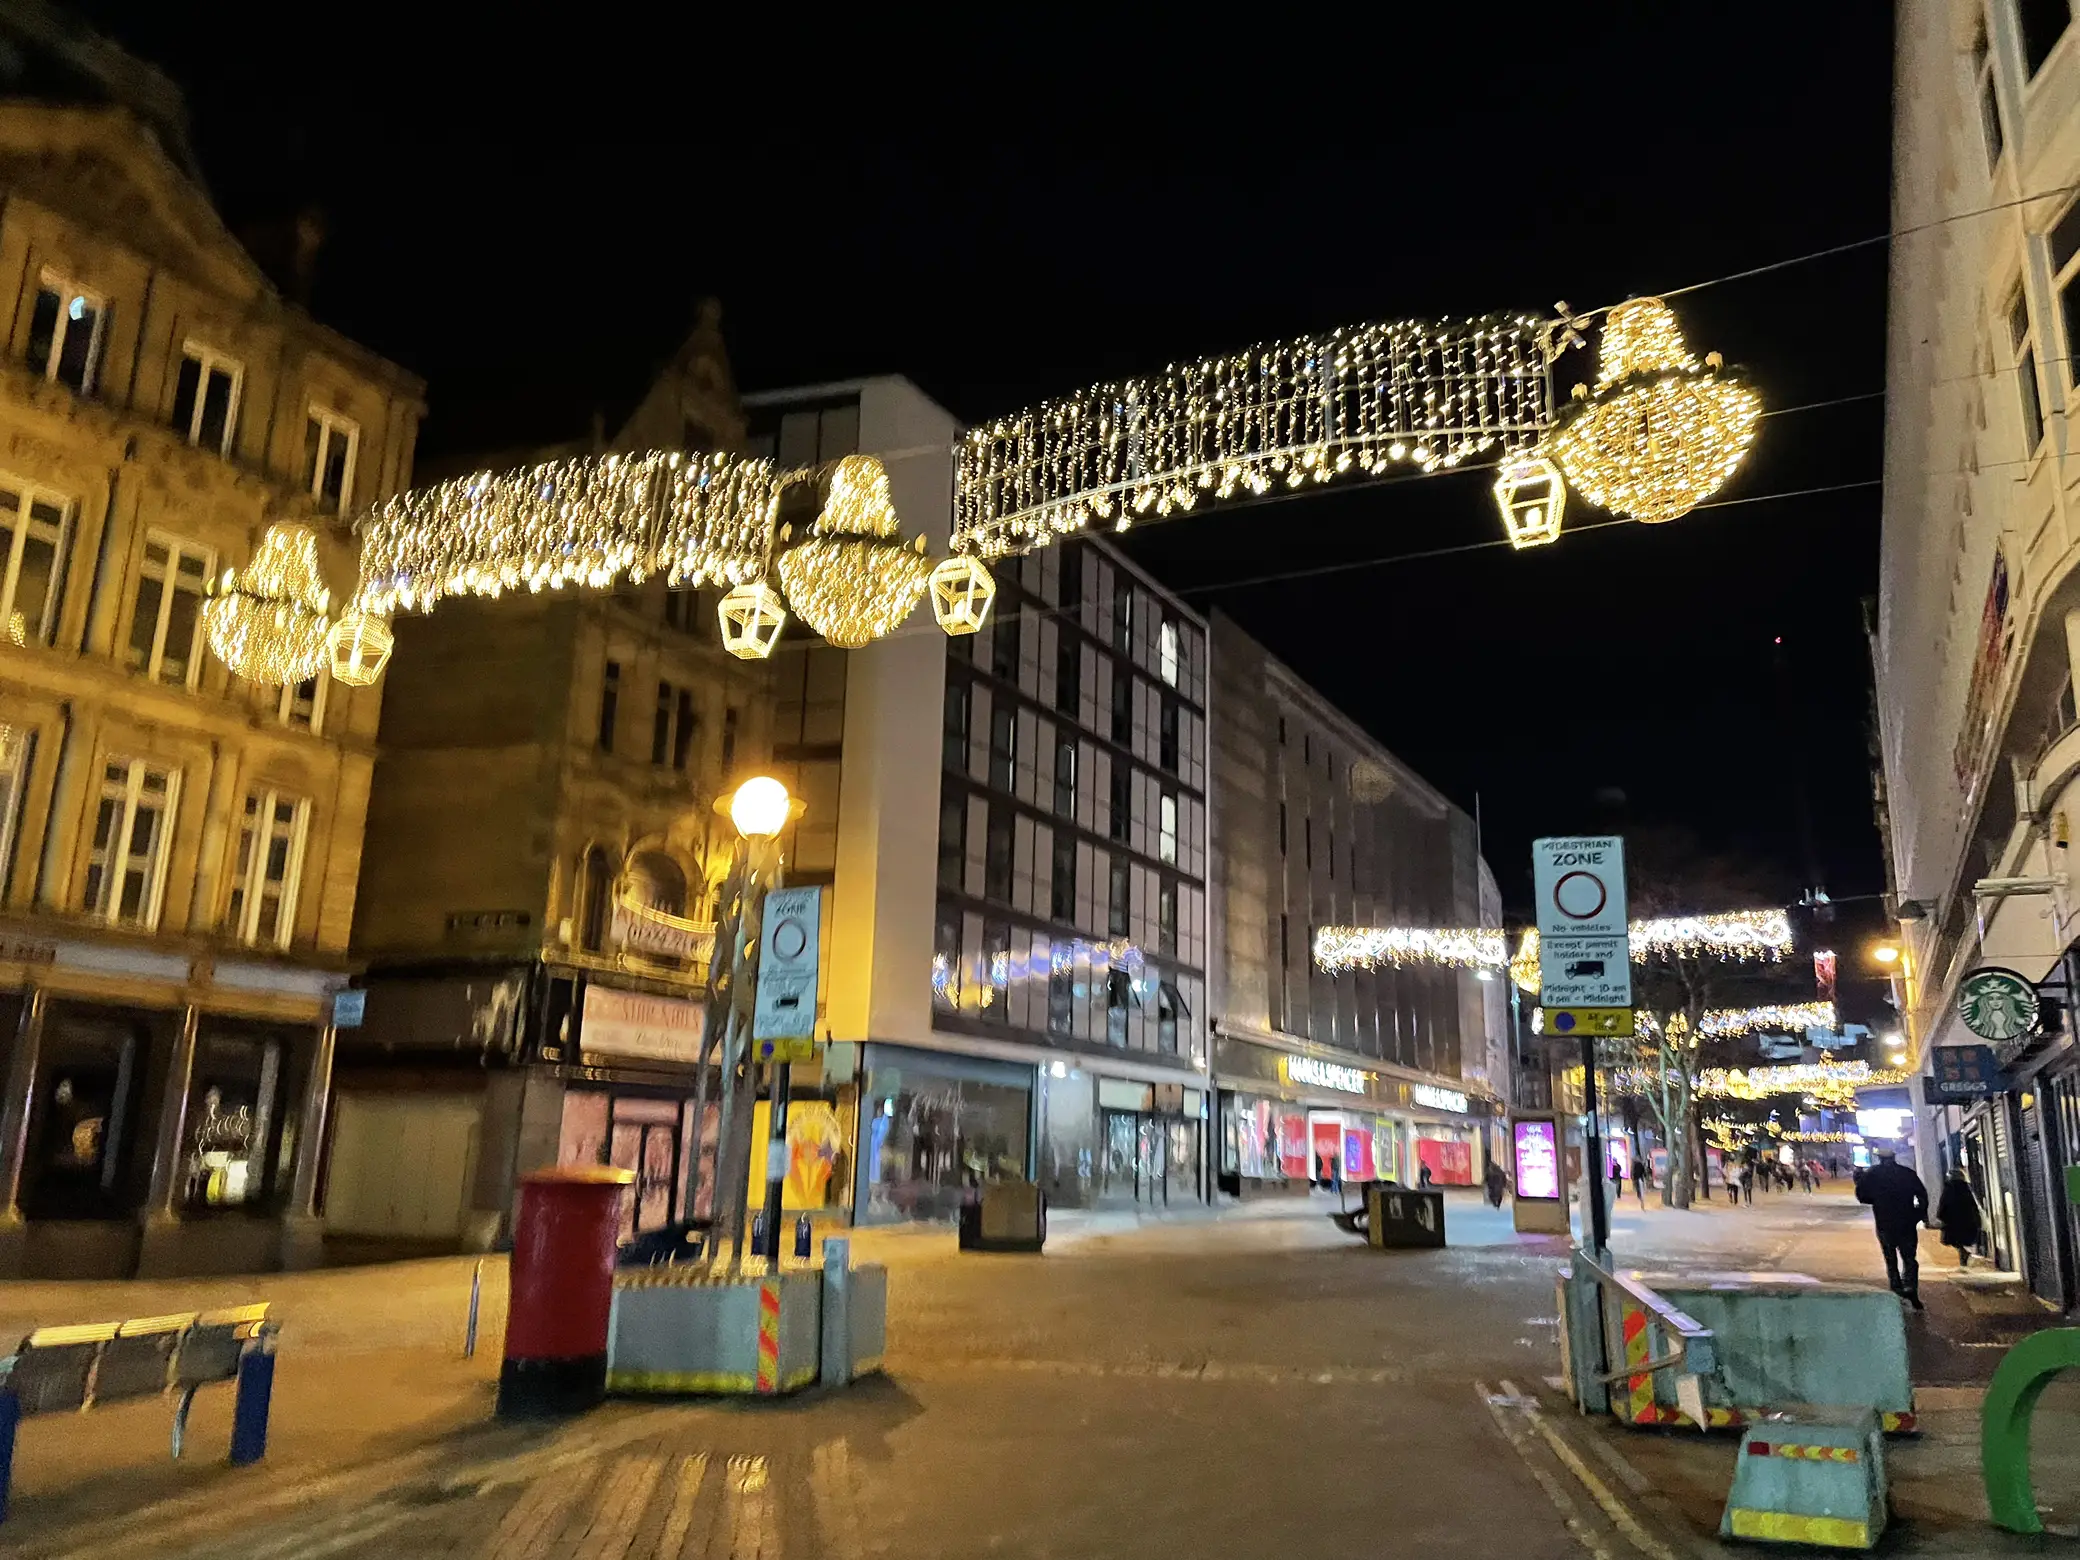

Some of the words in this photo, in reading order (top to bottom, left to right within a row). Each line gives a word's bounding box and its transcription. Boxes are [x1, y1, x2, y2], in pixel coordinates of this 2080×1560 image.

[1542, 841, 1612, 851] PEDESTRIAN
[1553, 852, 1604, 866] ZONE
[1552, 924, 1566, 932] No
[1570, 924, 1612, 932] vehicles
[1547, 940, 1580, 949] Except
[1585, 940, 1618, 949] permit
[1544, 983, 1585, 992] Midnight
[1600, 983, 1610, 992] 10
[1556, 995, 1570, 1004] pm
[1583, 994, 1625, 1003] Midnight
[1940, 1081, 1987, 1092] GREGGS
